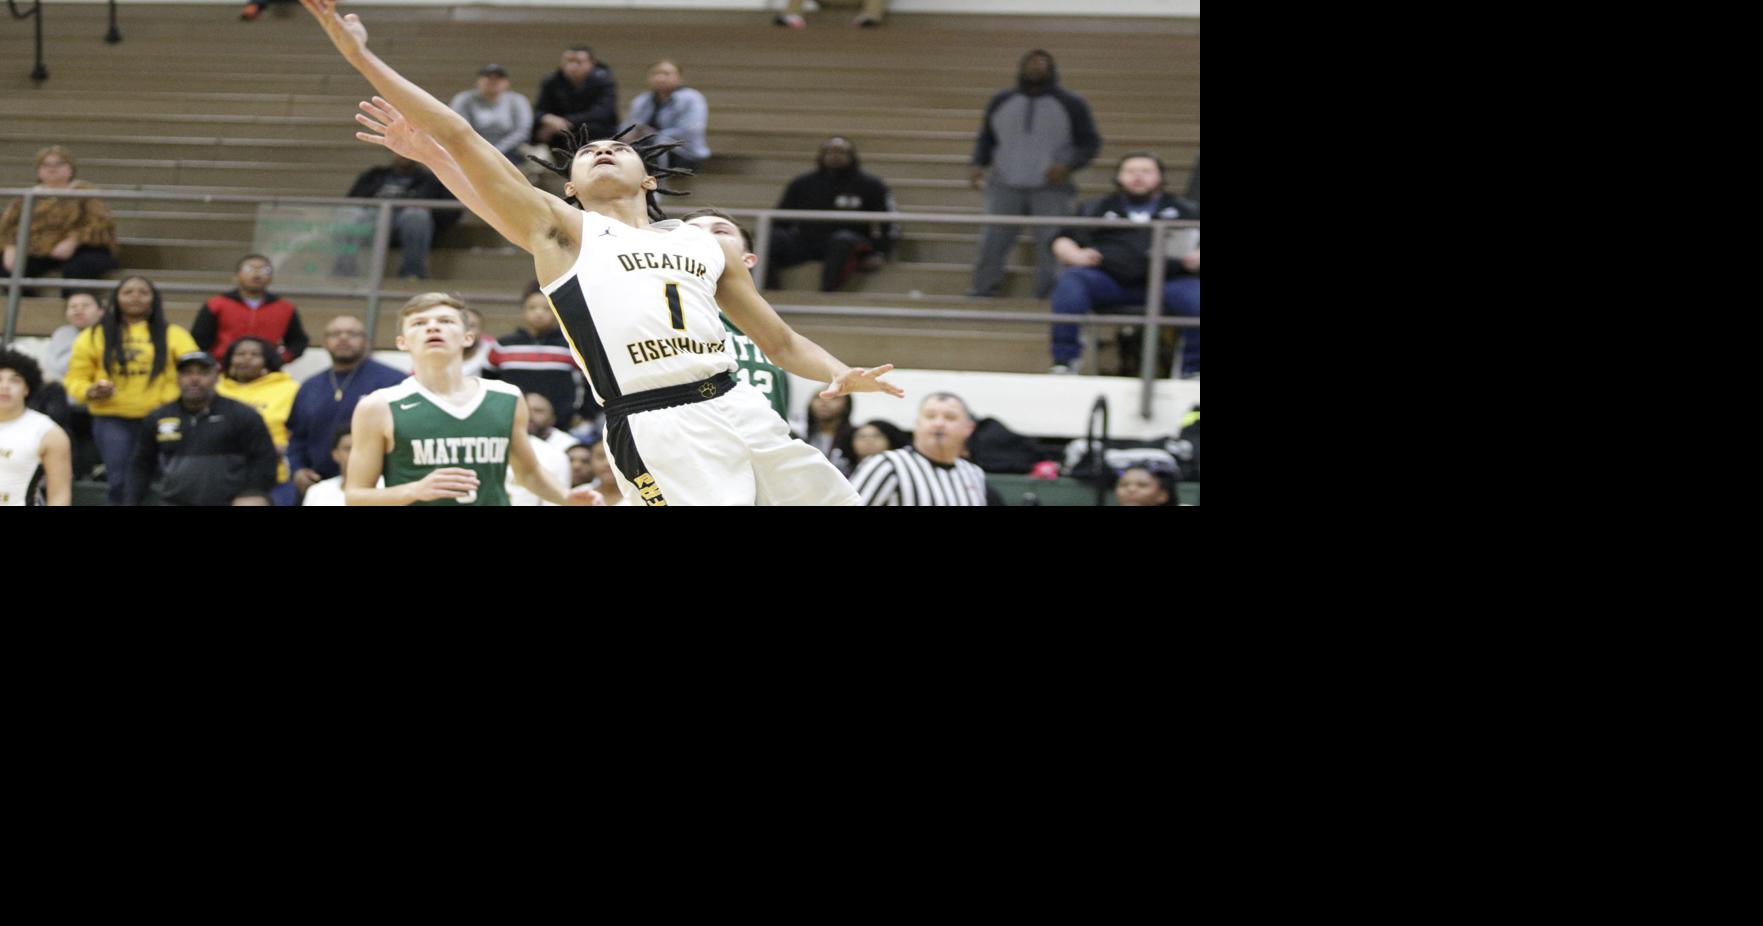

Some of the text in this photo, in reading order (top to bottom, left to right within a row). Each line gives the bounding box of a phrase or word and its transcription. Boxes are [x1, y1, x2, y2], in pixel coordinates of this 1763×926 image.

[617, 253, 706, 280] DECATUR
[663, 281, 687, 332] 1
[626, 336, 725, 365] EISENHO
